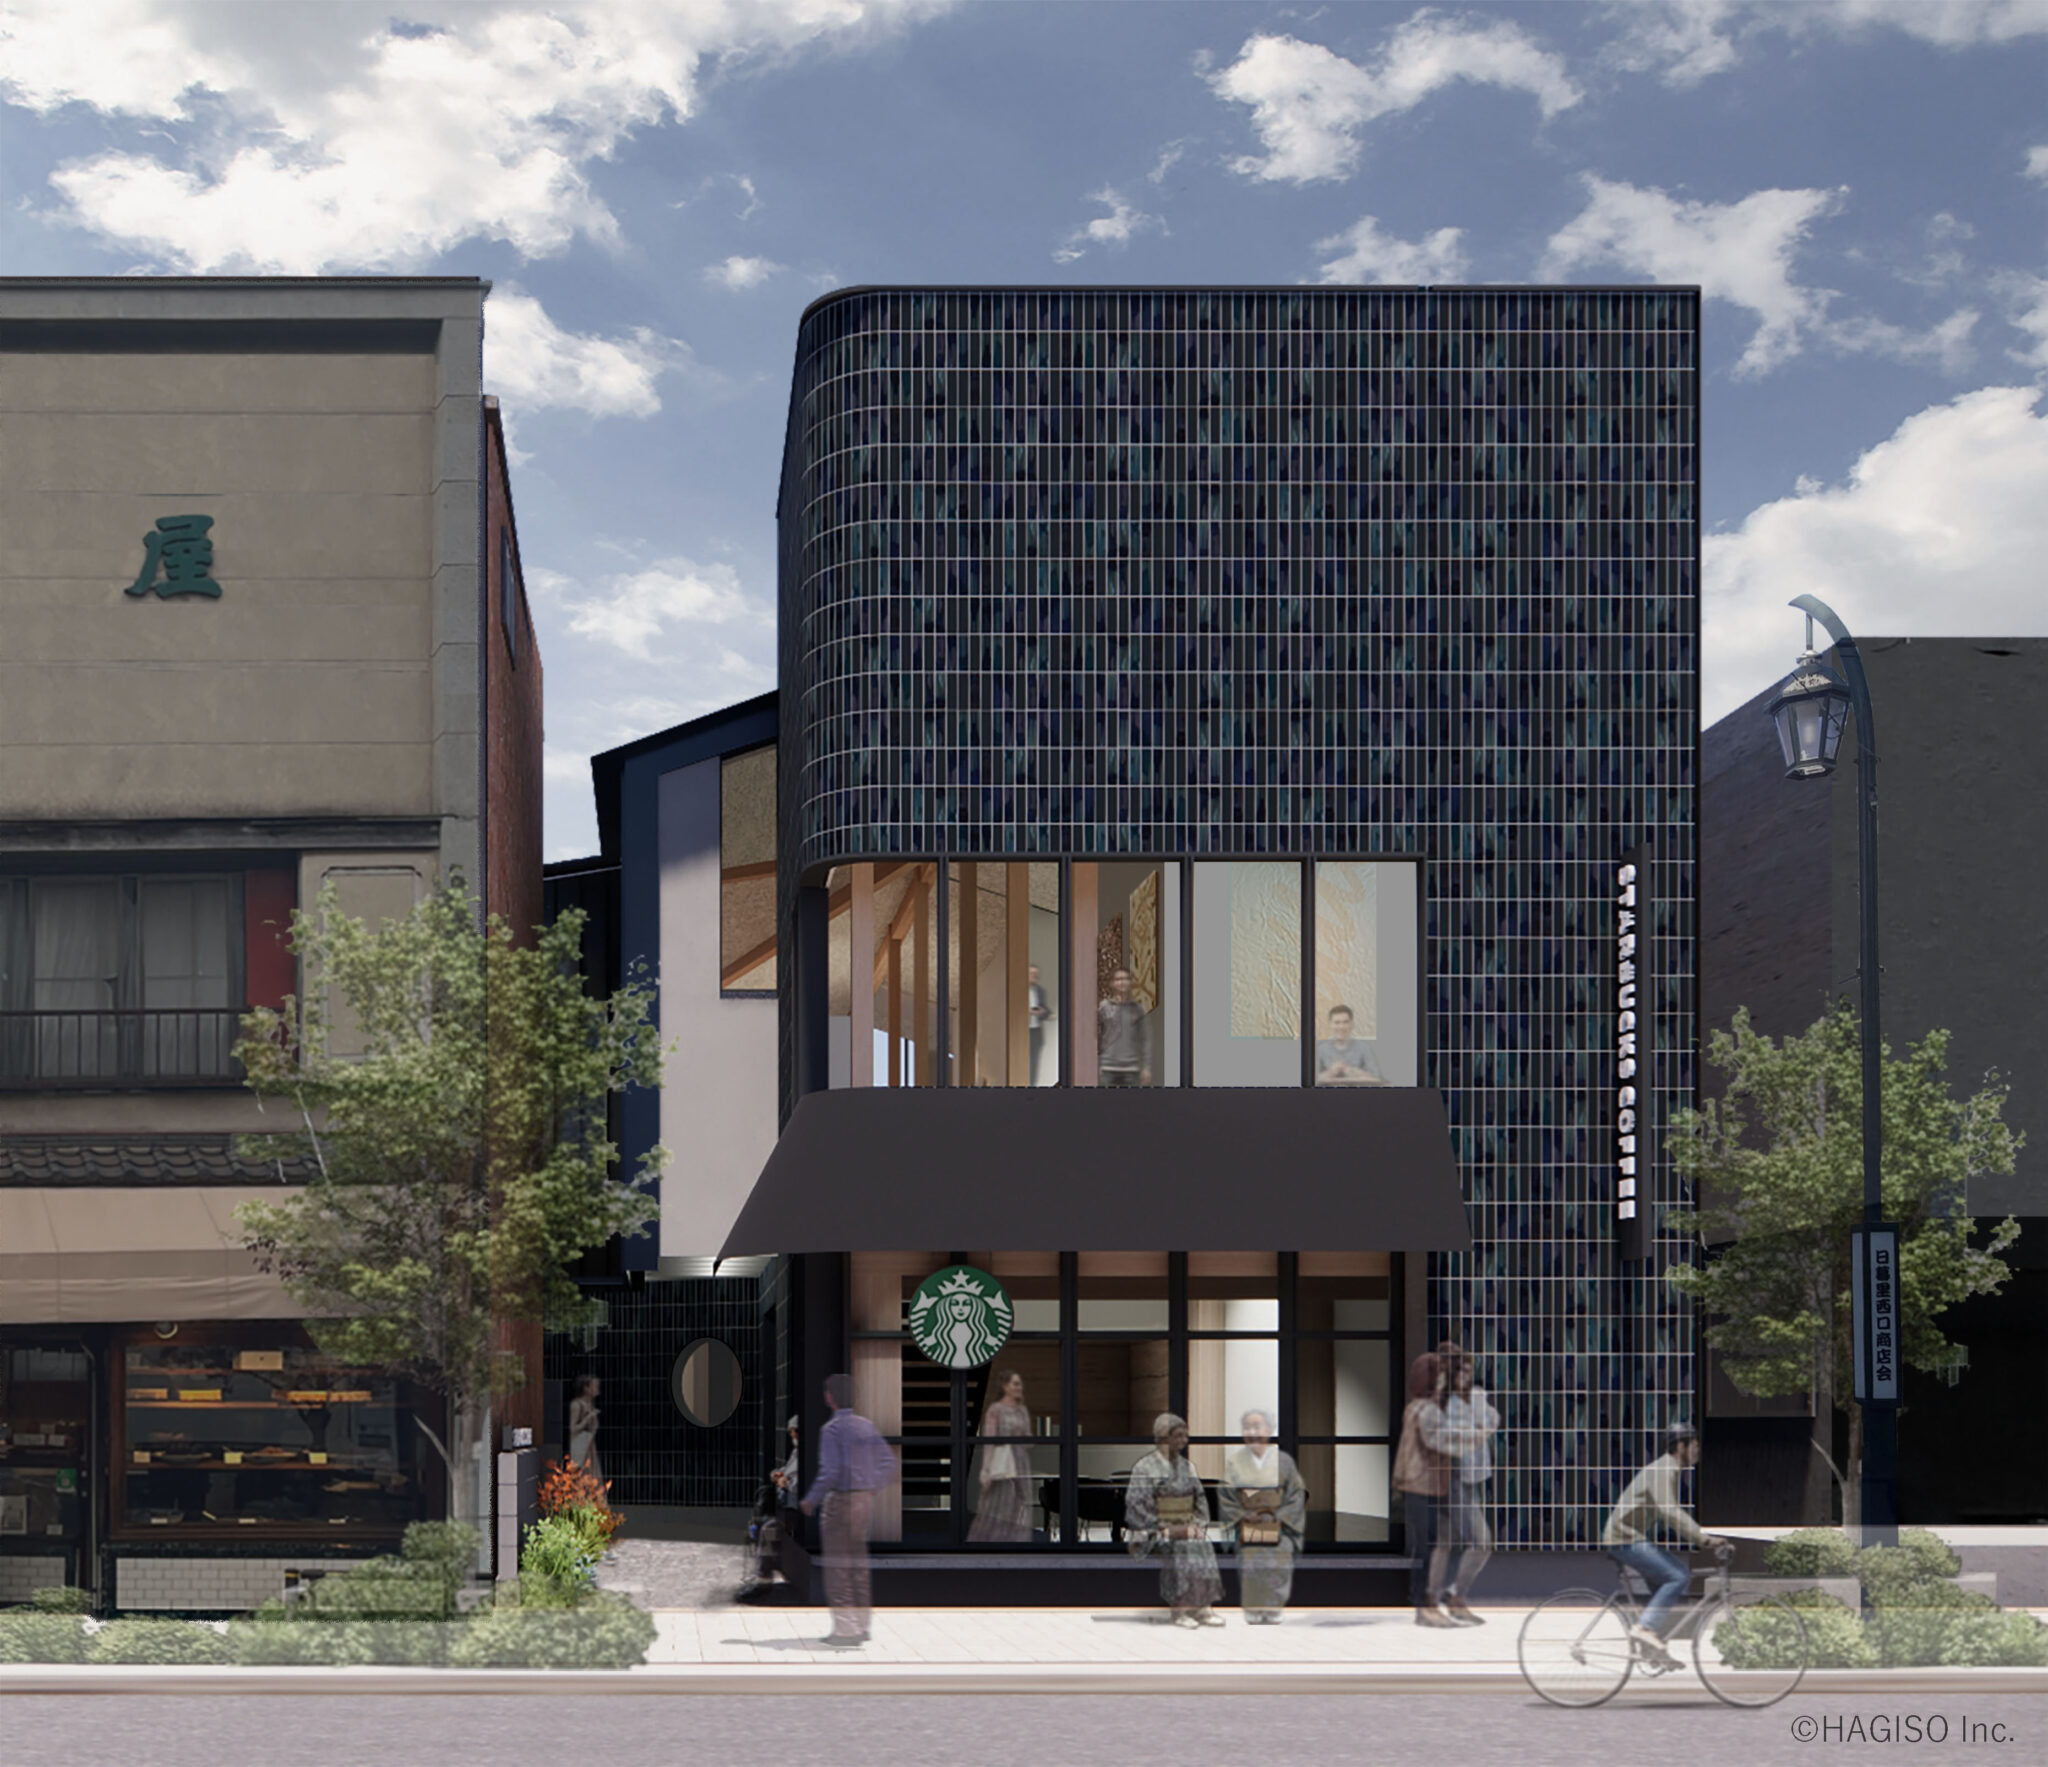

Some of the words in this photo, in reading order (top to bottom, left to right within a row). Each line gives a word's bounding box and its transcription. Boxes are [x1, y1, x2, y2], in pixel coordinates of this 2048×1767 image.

[124, 514, 222, 600] 屋
[1618, 864, 1636, 1079] STARBUCKS
[1618, 1085, 1636, 1220] COFFEE
[1875, 1250, 1892, 1382] 日暮里西口商店会
